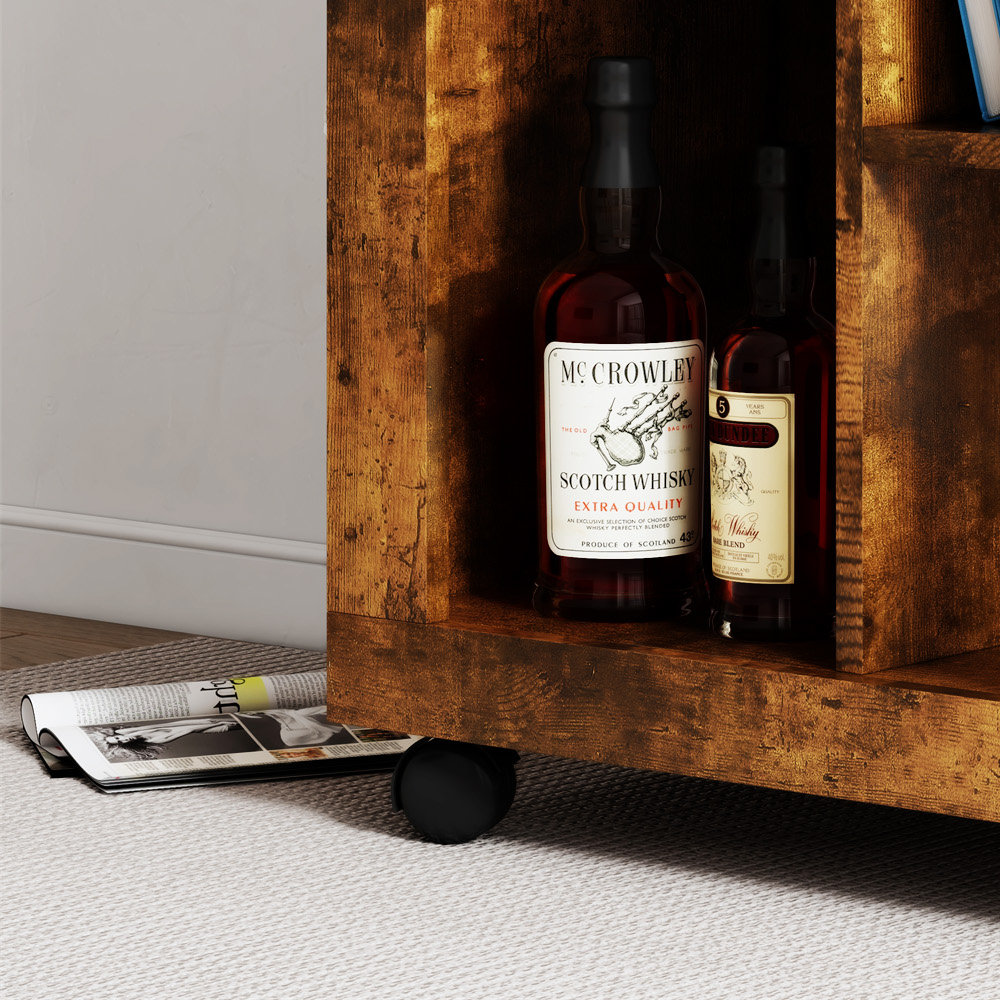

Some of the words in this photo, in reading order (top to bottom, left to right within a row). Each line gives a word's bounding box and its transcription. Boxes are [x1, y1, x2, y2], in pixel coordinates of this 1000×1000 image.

[718, 400, 726, 414] 5
[560, 471, 626, 491] SCOTCH
[632, 468, 695, 490] WHISKY
[574, 500, 618, 512] EXTRA
[625, 498, 683, 512] QUALITY
[724, 512, 761, 543] Whisky
[638, 538, 676, 548] SCOTLAND
[723, 539, 746, 549] BLEND
